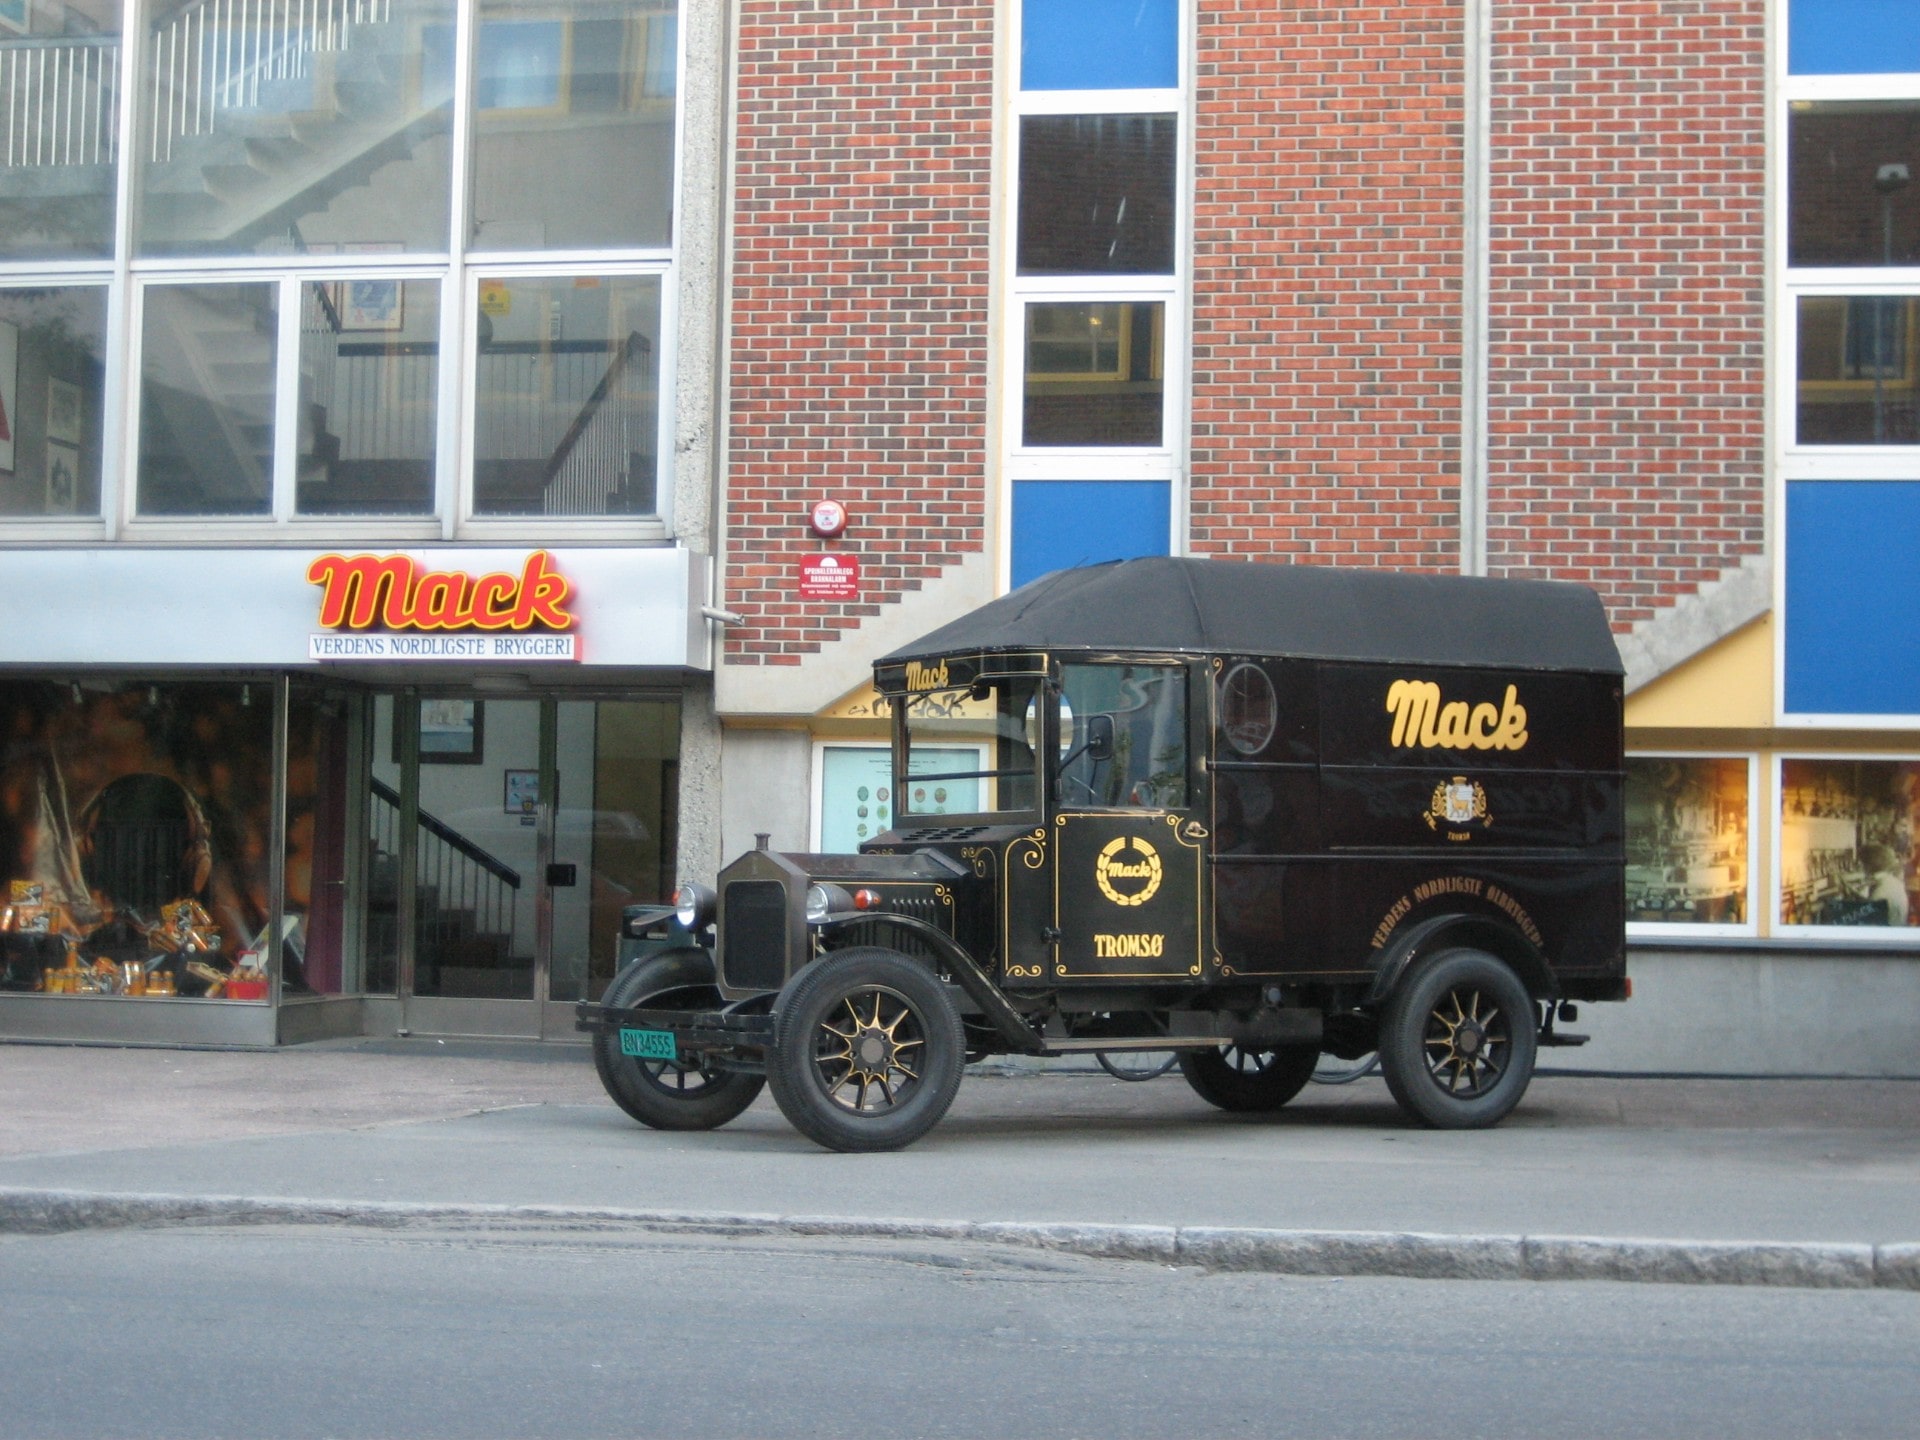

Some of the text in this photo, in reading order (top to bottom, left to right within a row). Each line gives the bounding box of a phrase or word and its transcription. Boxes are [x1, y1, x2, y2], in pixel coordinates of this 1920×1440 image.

[306, 550, 573, 629] Mack
[313, 637, 572, 656] VERDENS NORDLIGSTE BRYGGERI
[905, 658, 949, 692] Mack
[1386, 679, 1529, 751] Mack
[1107, 860, 1152, 878] Mack
[1370, 895, 1413, 949] VERDENS
[1413, 876, 1483, 903] NORDLIGSTE
[1094, 933, 1165, 958] TROMSØ
